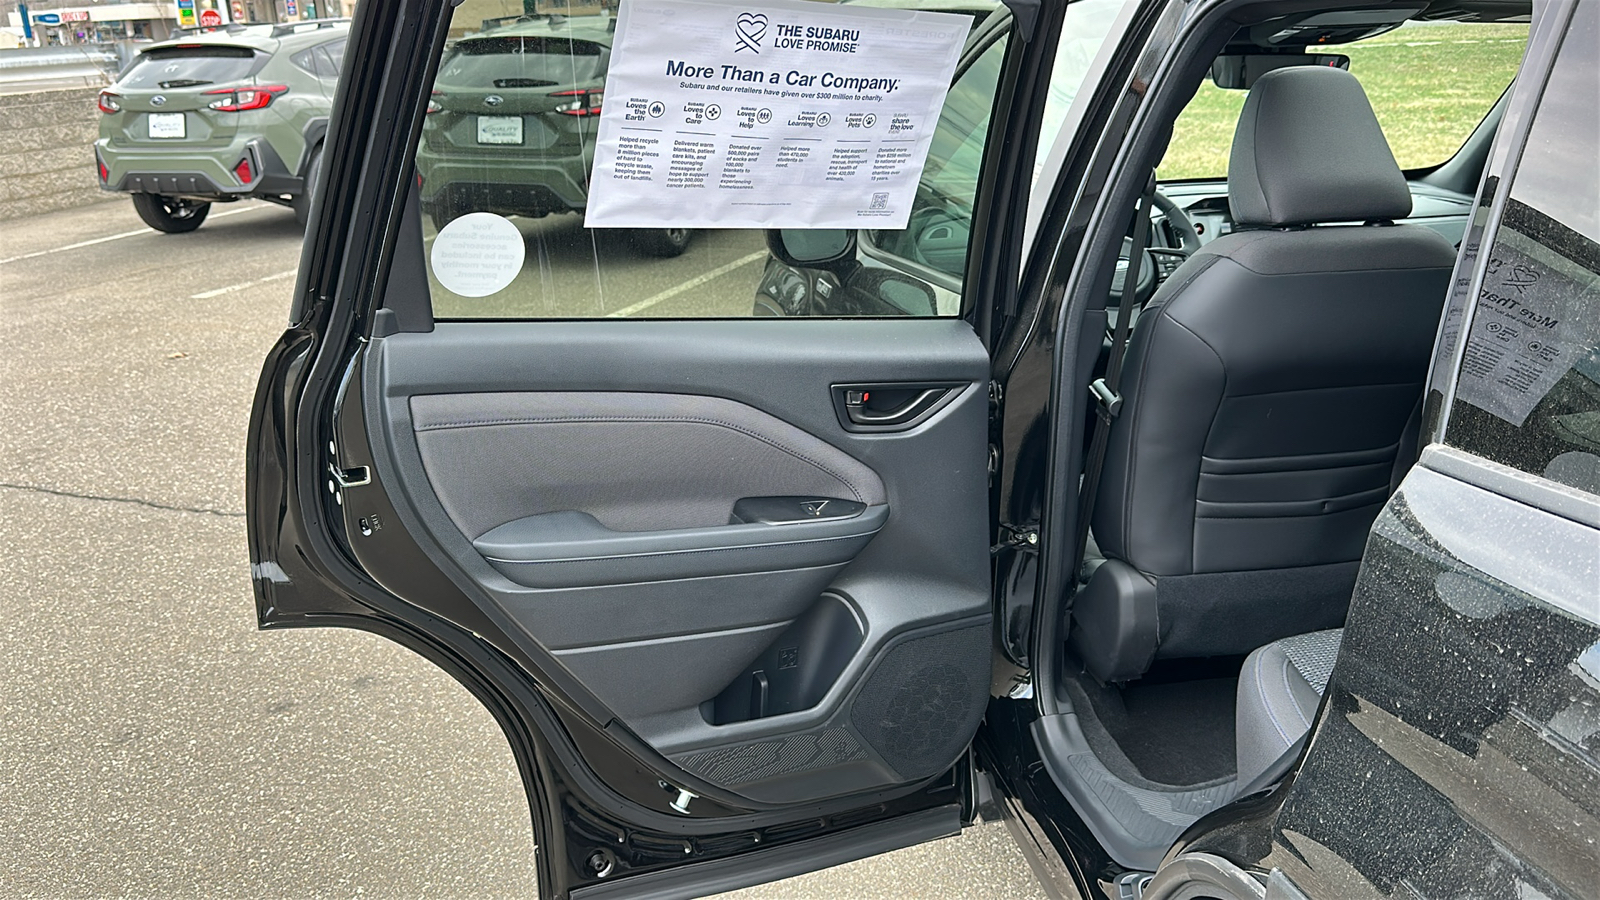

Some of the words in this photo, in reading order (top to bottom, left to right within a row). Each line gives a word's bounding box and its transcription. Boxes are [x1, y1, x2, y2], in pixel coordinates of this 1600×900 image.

[202, 16, 220, 26] STOP
[777, 24, 803, 38] THE
[806, 26, 860, 42] SUBARU
[774, 38, 803, 50] LOVE
[666, 60, 714, 79] More
[721, 65, 764, 82] Than
[769, 72, 779, 84] a
[785, 70, 817, 87] Car
